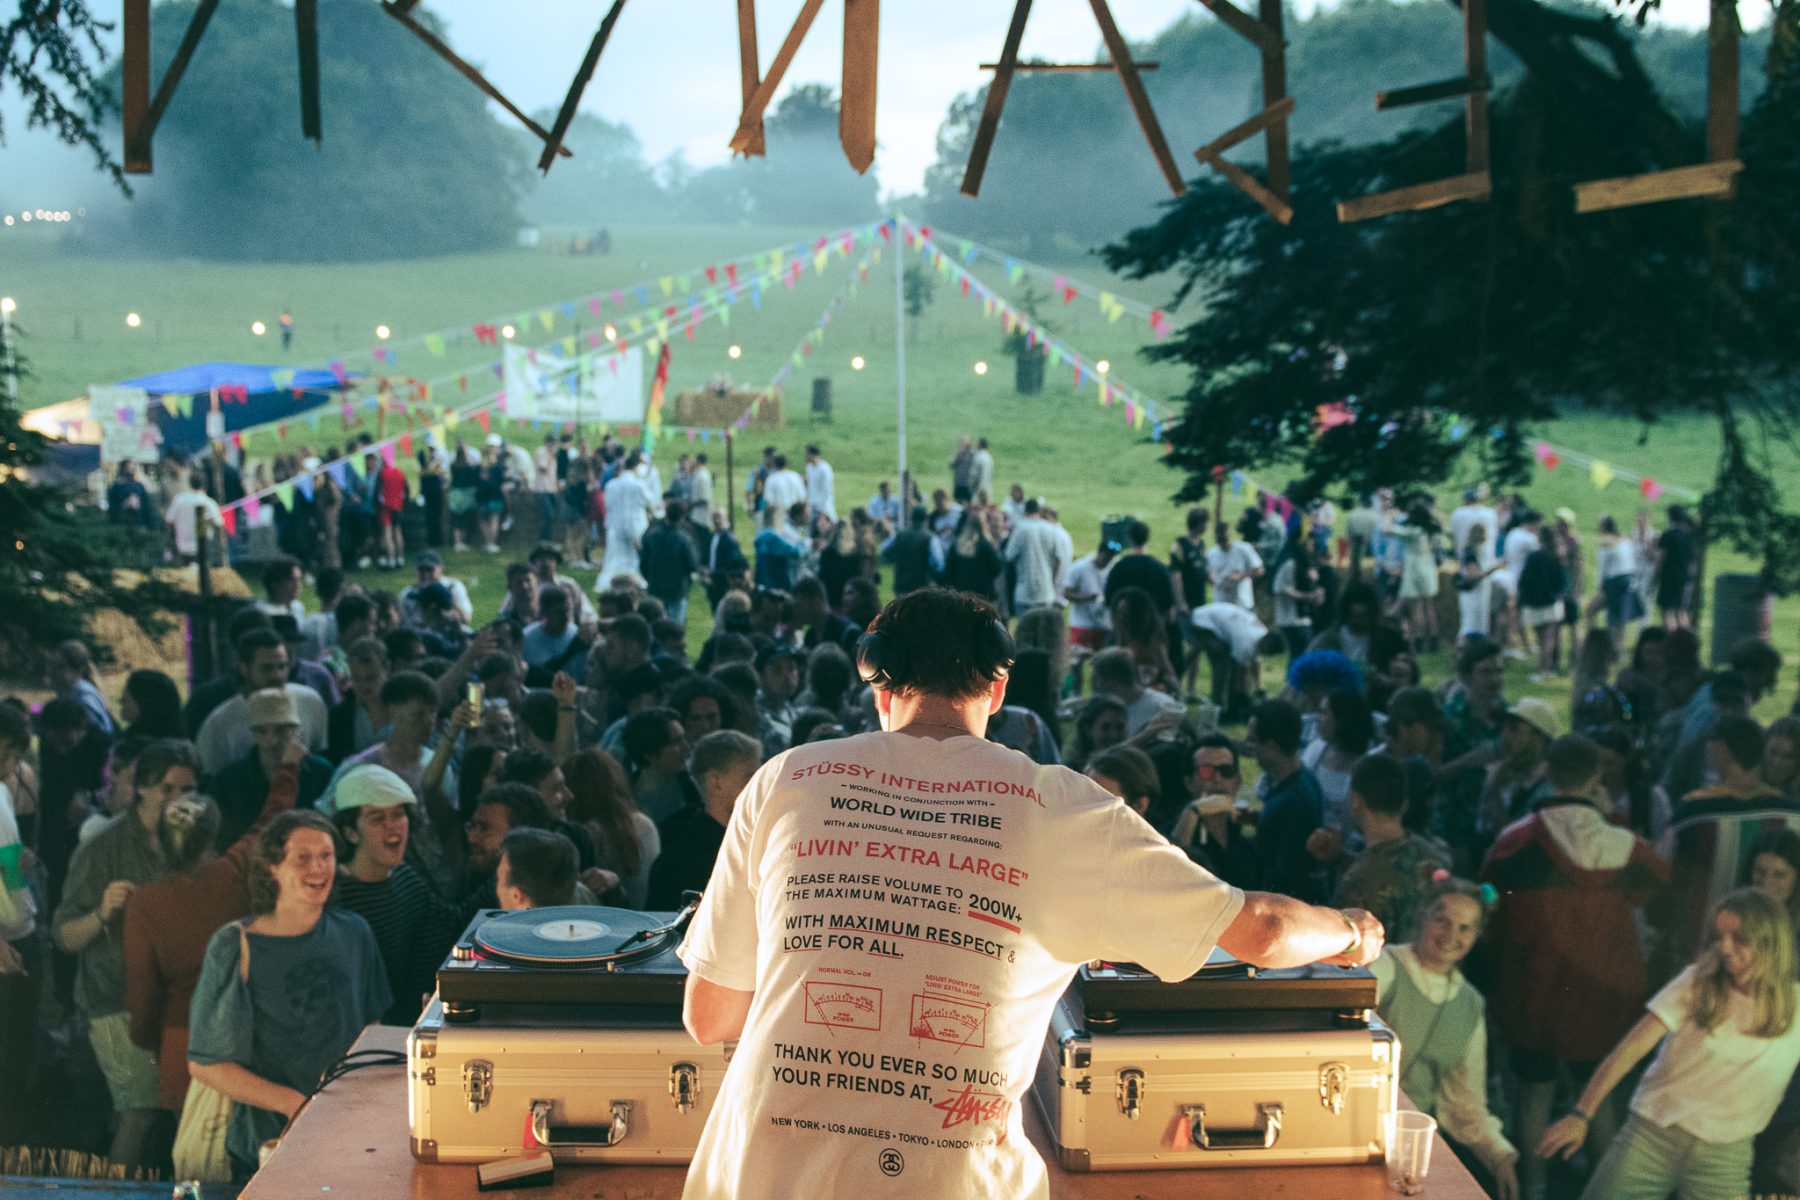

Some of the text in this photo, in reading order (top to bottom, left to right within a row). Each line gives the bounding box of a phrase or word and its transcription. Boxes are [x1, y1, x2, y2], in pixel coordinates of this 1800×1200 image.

[791, 761, 1046, 808] STÜSSY INTERNATIONAL
[849, 784, 890, 798] WORKING
[903, 796, 964, 806] CONJUNCTION
[831, 797, 1002, 830] WORLD WIDE TRIBE
[823, 819, 845, 828] WITH
[861, 823, 904, 835] UNUSUAL
[906, 829, 948, 840] REQUEST
[950, 834, 1003, 849] REGARDING:
[865, 841, 941, 867] EXTRA
[787, 873, 963, 899] PLEASE RAISE VOLUME TO
[786, 888, 1023, 922] THE MAXIMUM WATTAGE: 200W+
[784, 935, 904, 957] LOVE FOR ALL.
[785, 914, 824, 930] WITH
[829, 914, 920, 937] MAXIMUM
[926, 926, 1004, 957] RESPECT
[944, 984, 963, 993] EXTRA
[948, 978, 968, 987] POWER
[774, 1043, 1008, 1087] THANK YOU EVER SO MUCH
[772, 1066, 933, 1105] YOUR FRIENDS AT,
[771, 1117, 792, 1126] NEW
[794, 1119, 820, 1131] YORK
[827, 1123, 846, 1134] LOS
[848, 1126, 890, 1140] ANGELES
[898, 1132, 929, 1146] TOKYO
[937, 1139, 974, 1149] LONDON
